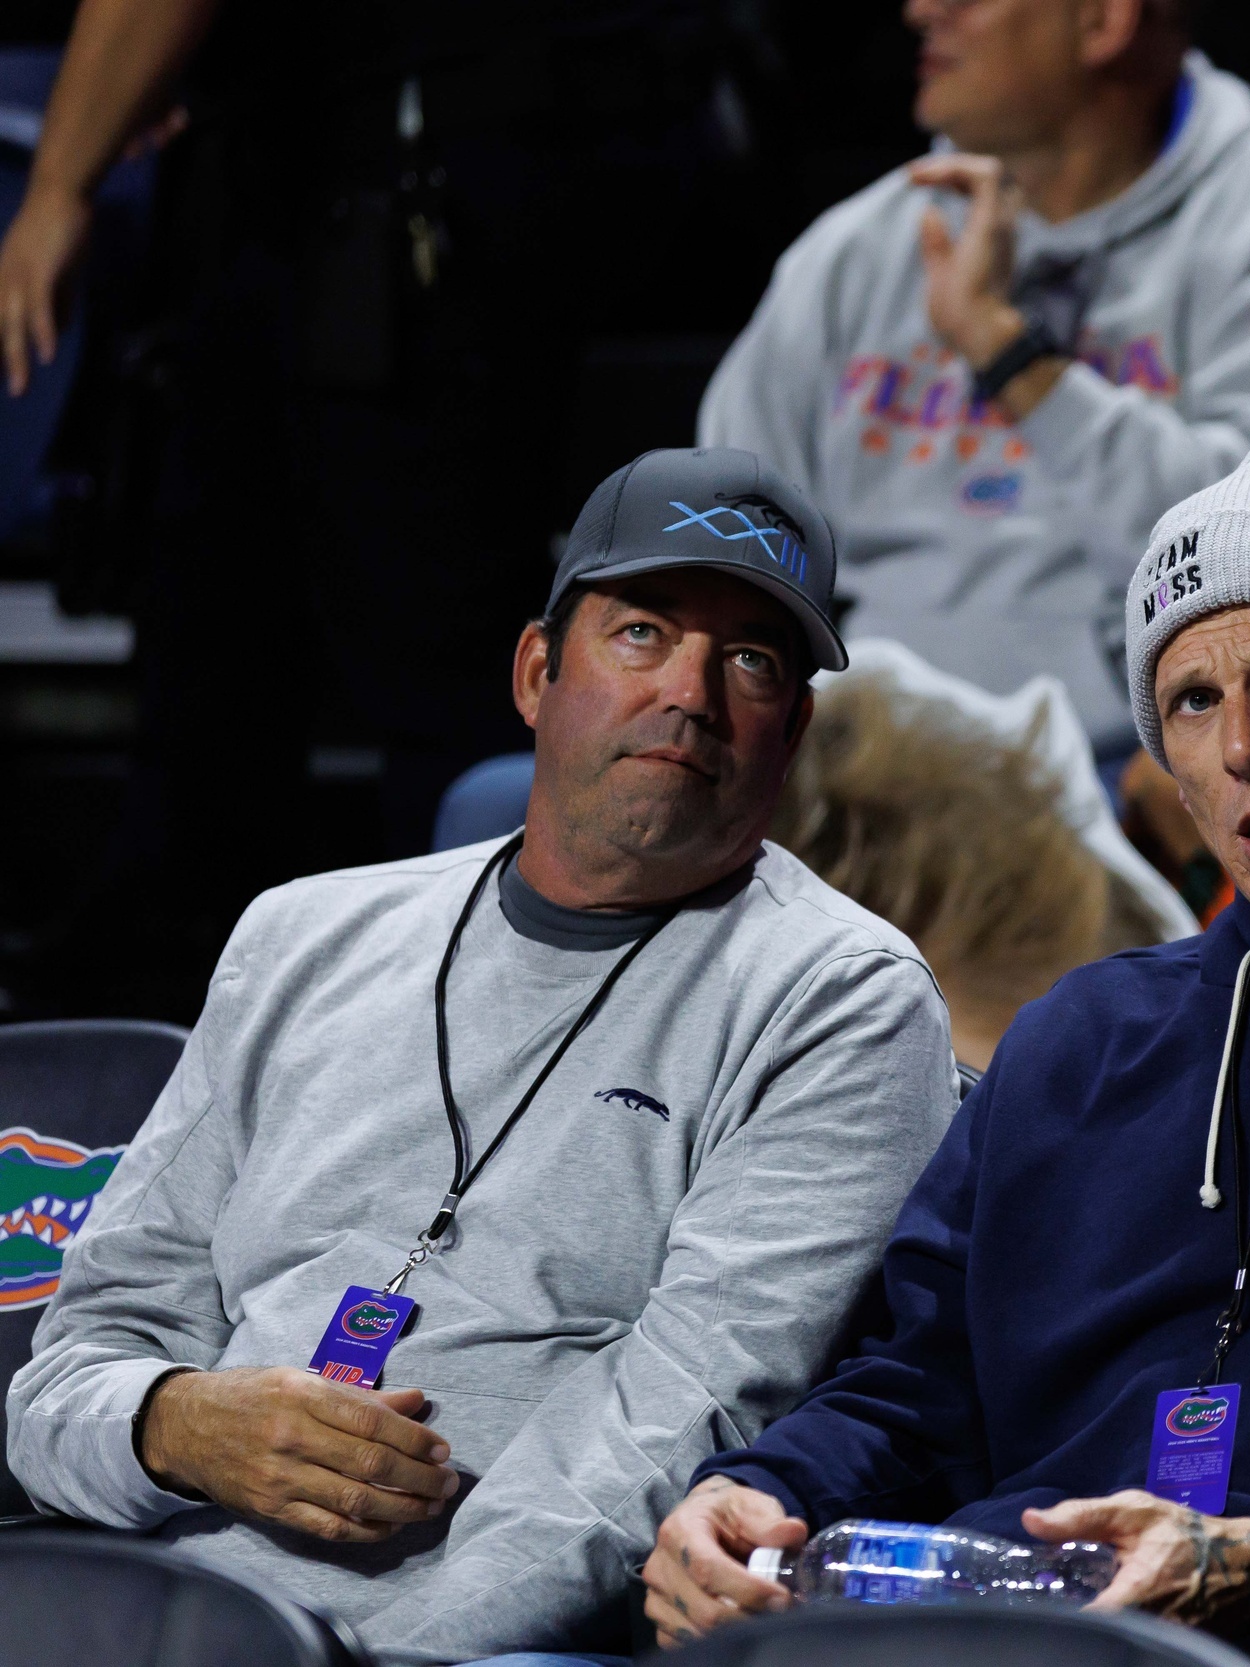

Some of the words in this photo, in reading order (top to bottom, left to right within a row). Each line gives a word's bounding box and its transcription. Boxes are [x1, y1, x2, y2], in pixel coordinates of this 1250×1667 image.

[662, 501, 808, 585] XXIII
[1146, 531, 1199, 585] EAM
[320, 1360, 364, 1385] VIP
